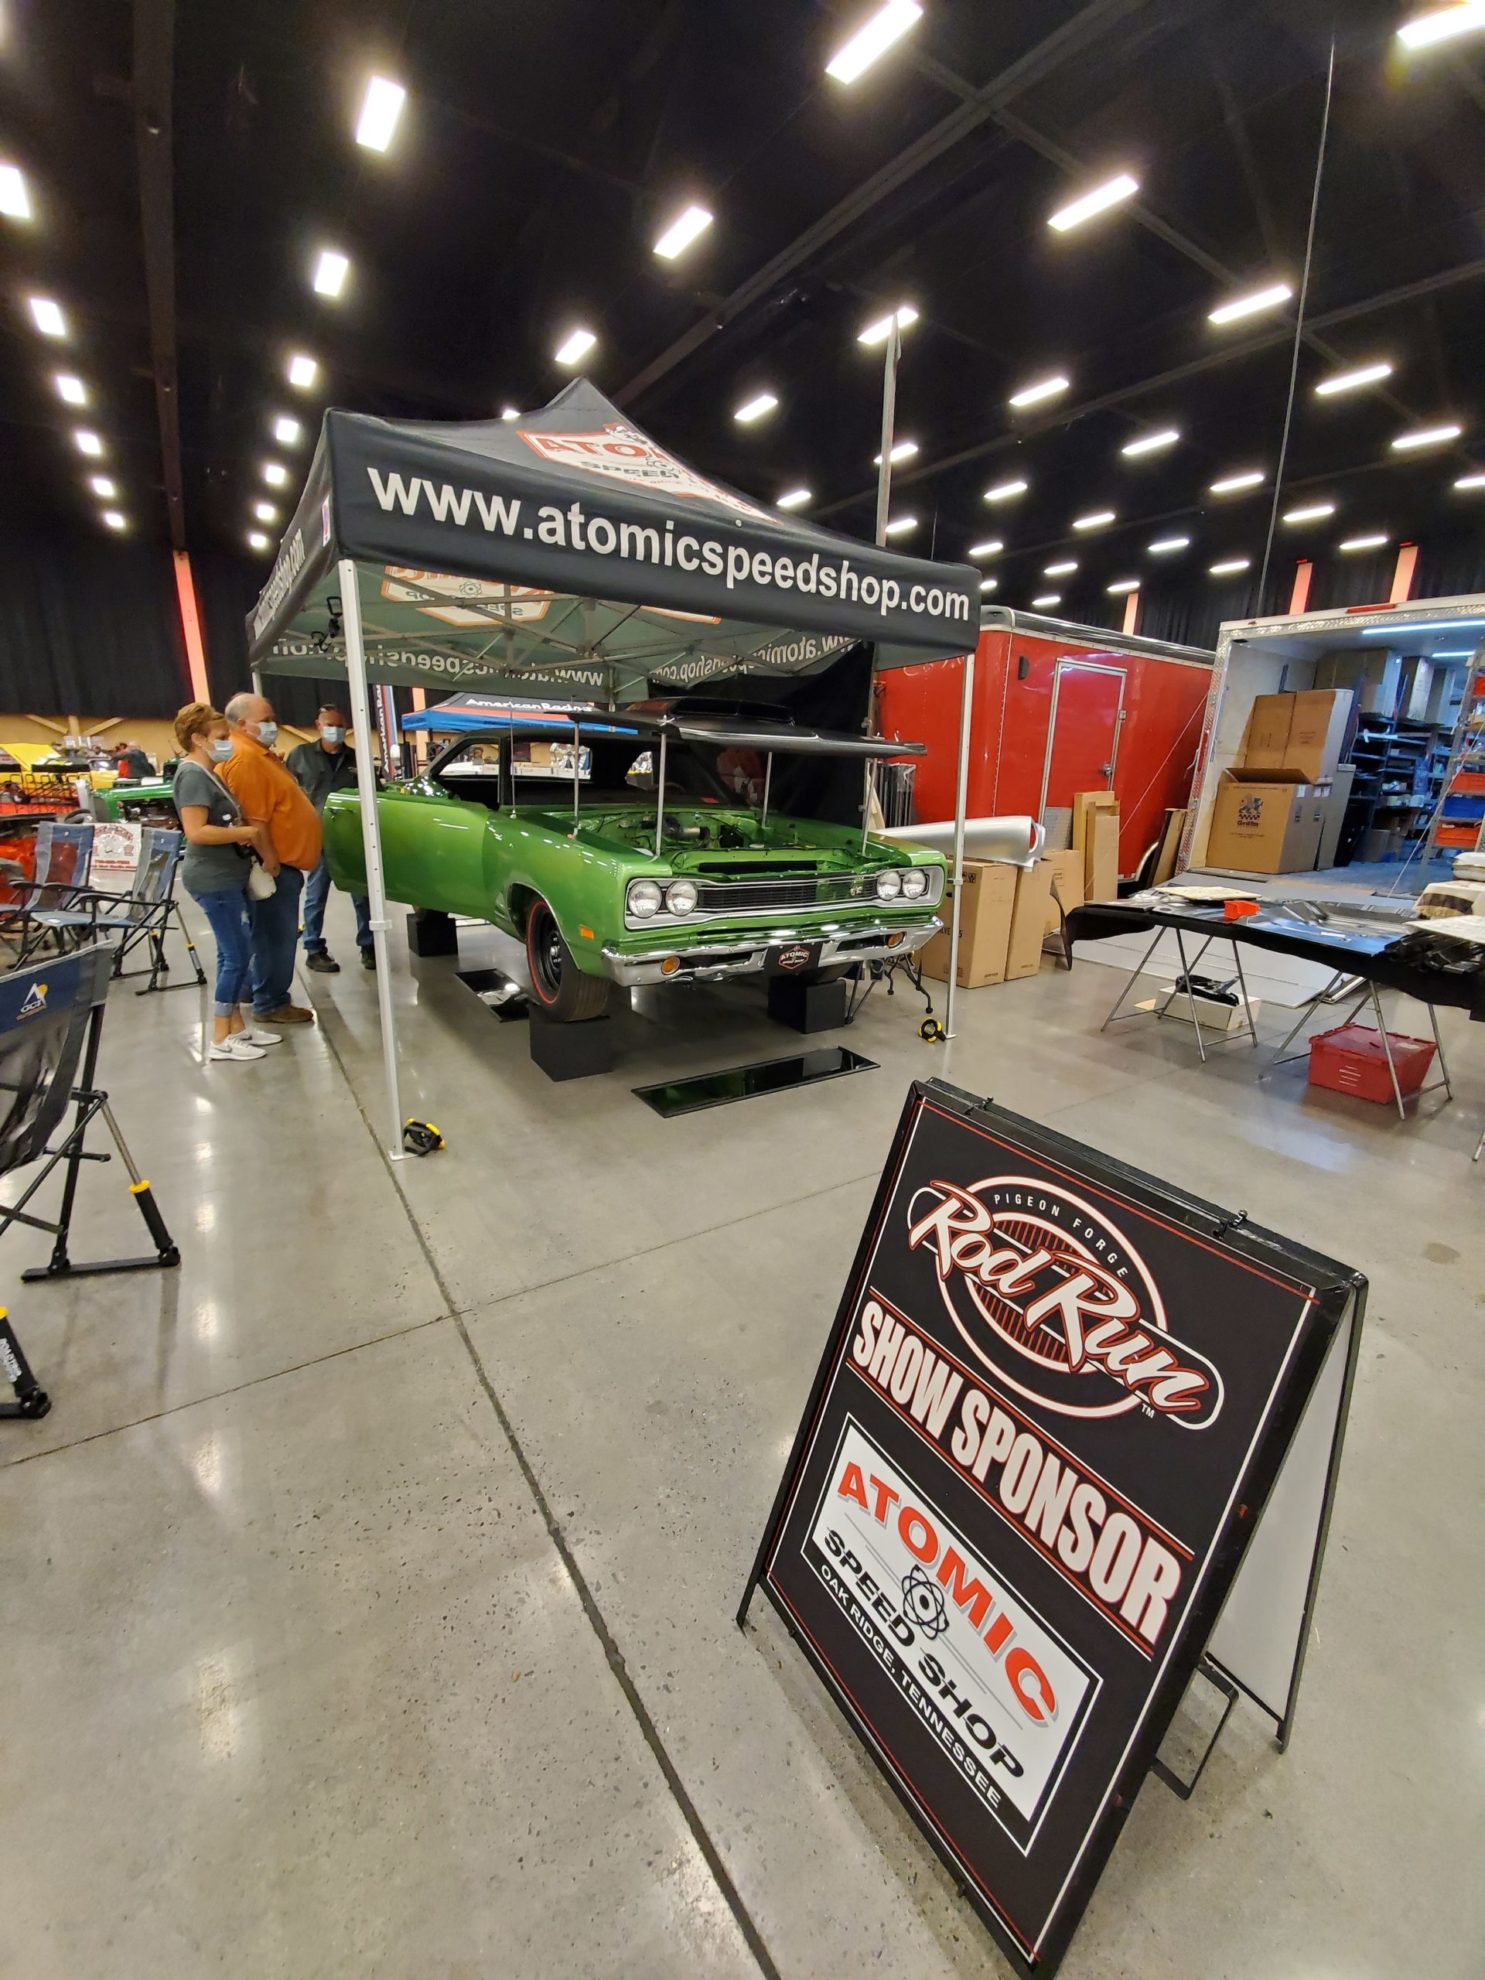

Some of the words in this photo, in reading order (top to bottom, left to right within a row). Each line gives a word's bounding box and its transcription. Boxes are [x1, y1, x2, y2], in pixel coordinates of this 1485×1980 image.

[366, 466, 969, 621] www.atomicspeedshop.com
[377, 709, 390, 773] American
[466, 698, 541, 710] American
[781, 951, 809, 960] ATOMIC
[908, 1180, 1053, 1298] Rod
[1024, 1249, 1210, 1412] Run
[994, 1194, 1060, 1217] PIGEON
[1072, 1218, 1129, 1279] FORGE
[852, 1300, 964, 1440] SHOW
[951, 1388, 1182, 1646] SPONSOR
[1140, 1403, 1155, 1419] TM
[823, 1529, 916, 1648] SPEED
[918, 1650, 1025, 1779] SHOP
[836, 1460, 1058, 1724] ATOMIC
[820, 1564, 850, 1609] OAK
[850, 1605, 897, 1675] RIDGE,
[900, 1671, 1002, 1809] TENNESSEE
